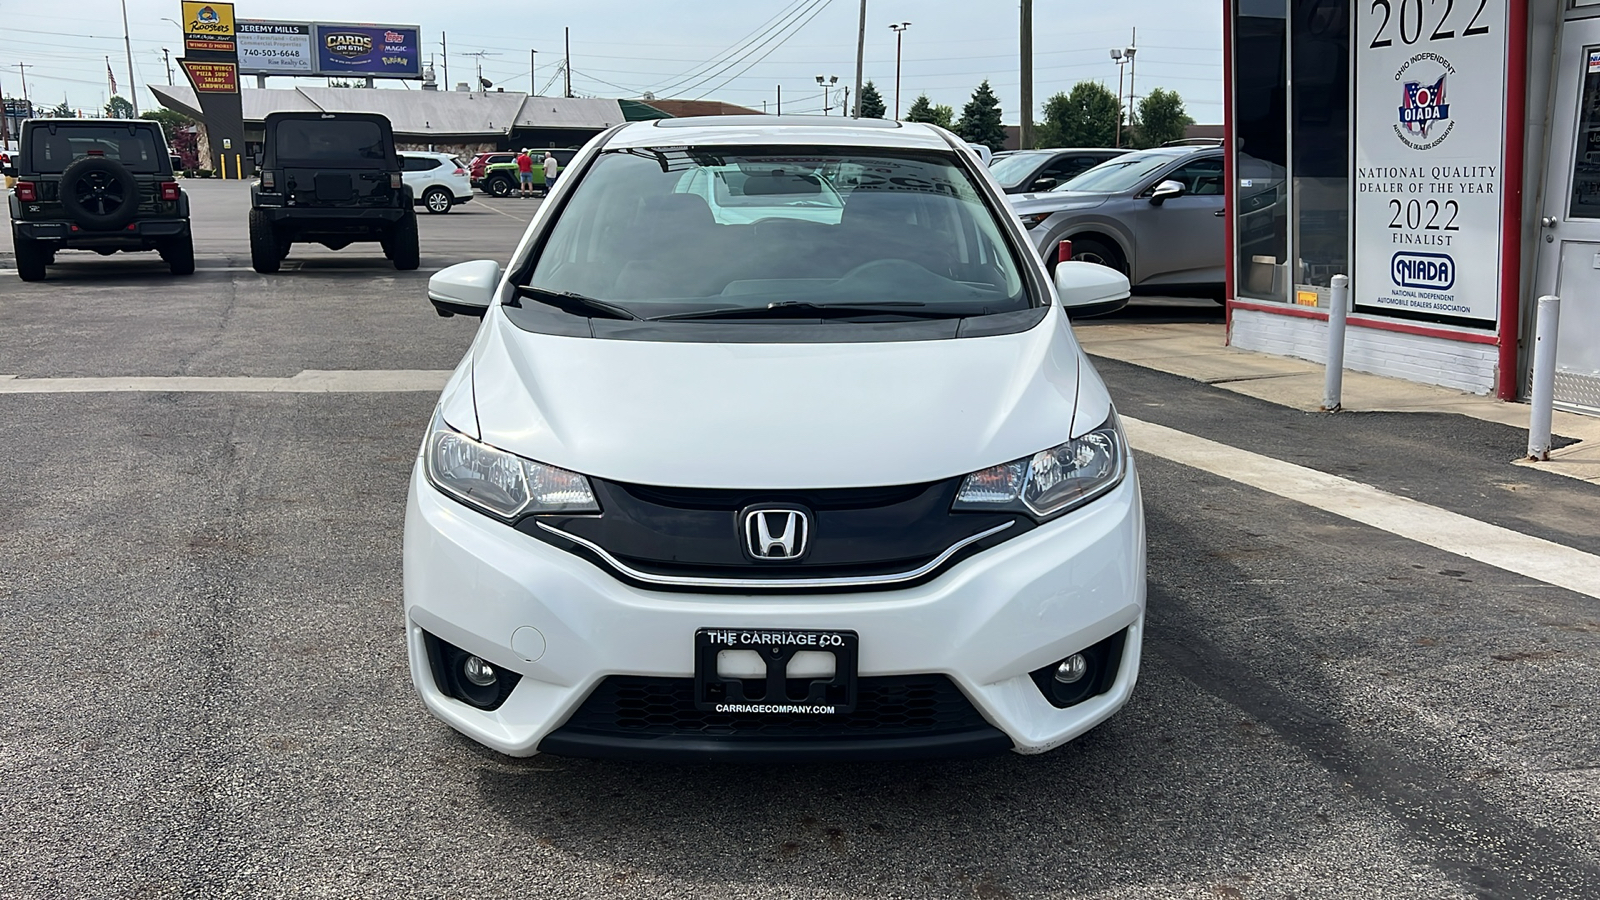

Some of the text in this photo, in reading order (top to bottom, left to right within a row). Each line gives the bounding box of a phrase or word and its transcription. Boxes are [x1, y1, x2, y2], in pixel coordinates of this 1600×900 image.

[190, 20, 229, 32] Roosters
[240, 24, 300, 34] JEREMY MILLS
[327, 35, 372, 48] CARDS
[243, 48, 300, 58] 740-503-6648
[1394, 52, 1456, 81] OHIO INDEPENDENT
[1404, 106, 1440, 121] OIADA
[1431, 120, 1455, 148] ASSOCIATION
[1358, 166, 1497, 180] NATIONAL QUALITY
[1360, 182, 1494, 193] DEALER OF THE YEAR
[1388, 198, 1460, 231] 2022
[1392, 233, 1453, 246] FINALIST
[1396, 259, 1449, 282] NIADA
[1391, 289, 1455, 302] NATIONAL INDEPENDENT
[1377, 297, 1471, 313] AUTOMOBILE DEALERS ASSOCIATION
[708, 632, 846, 647] THE CARRIAGE CO.
[715, 703, 835, 714] CARRIAGECOMPANY.COM
